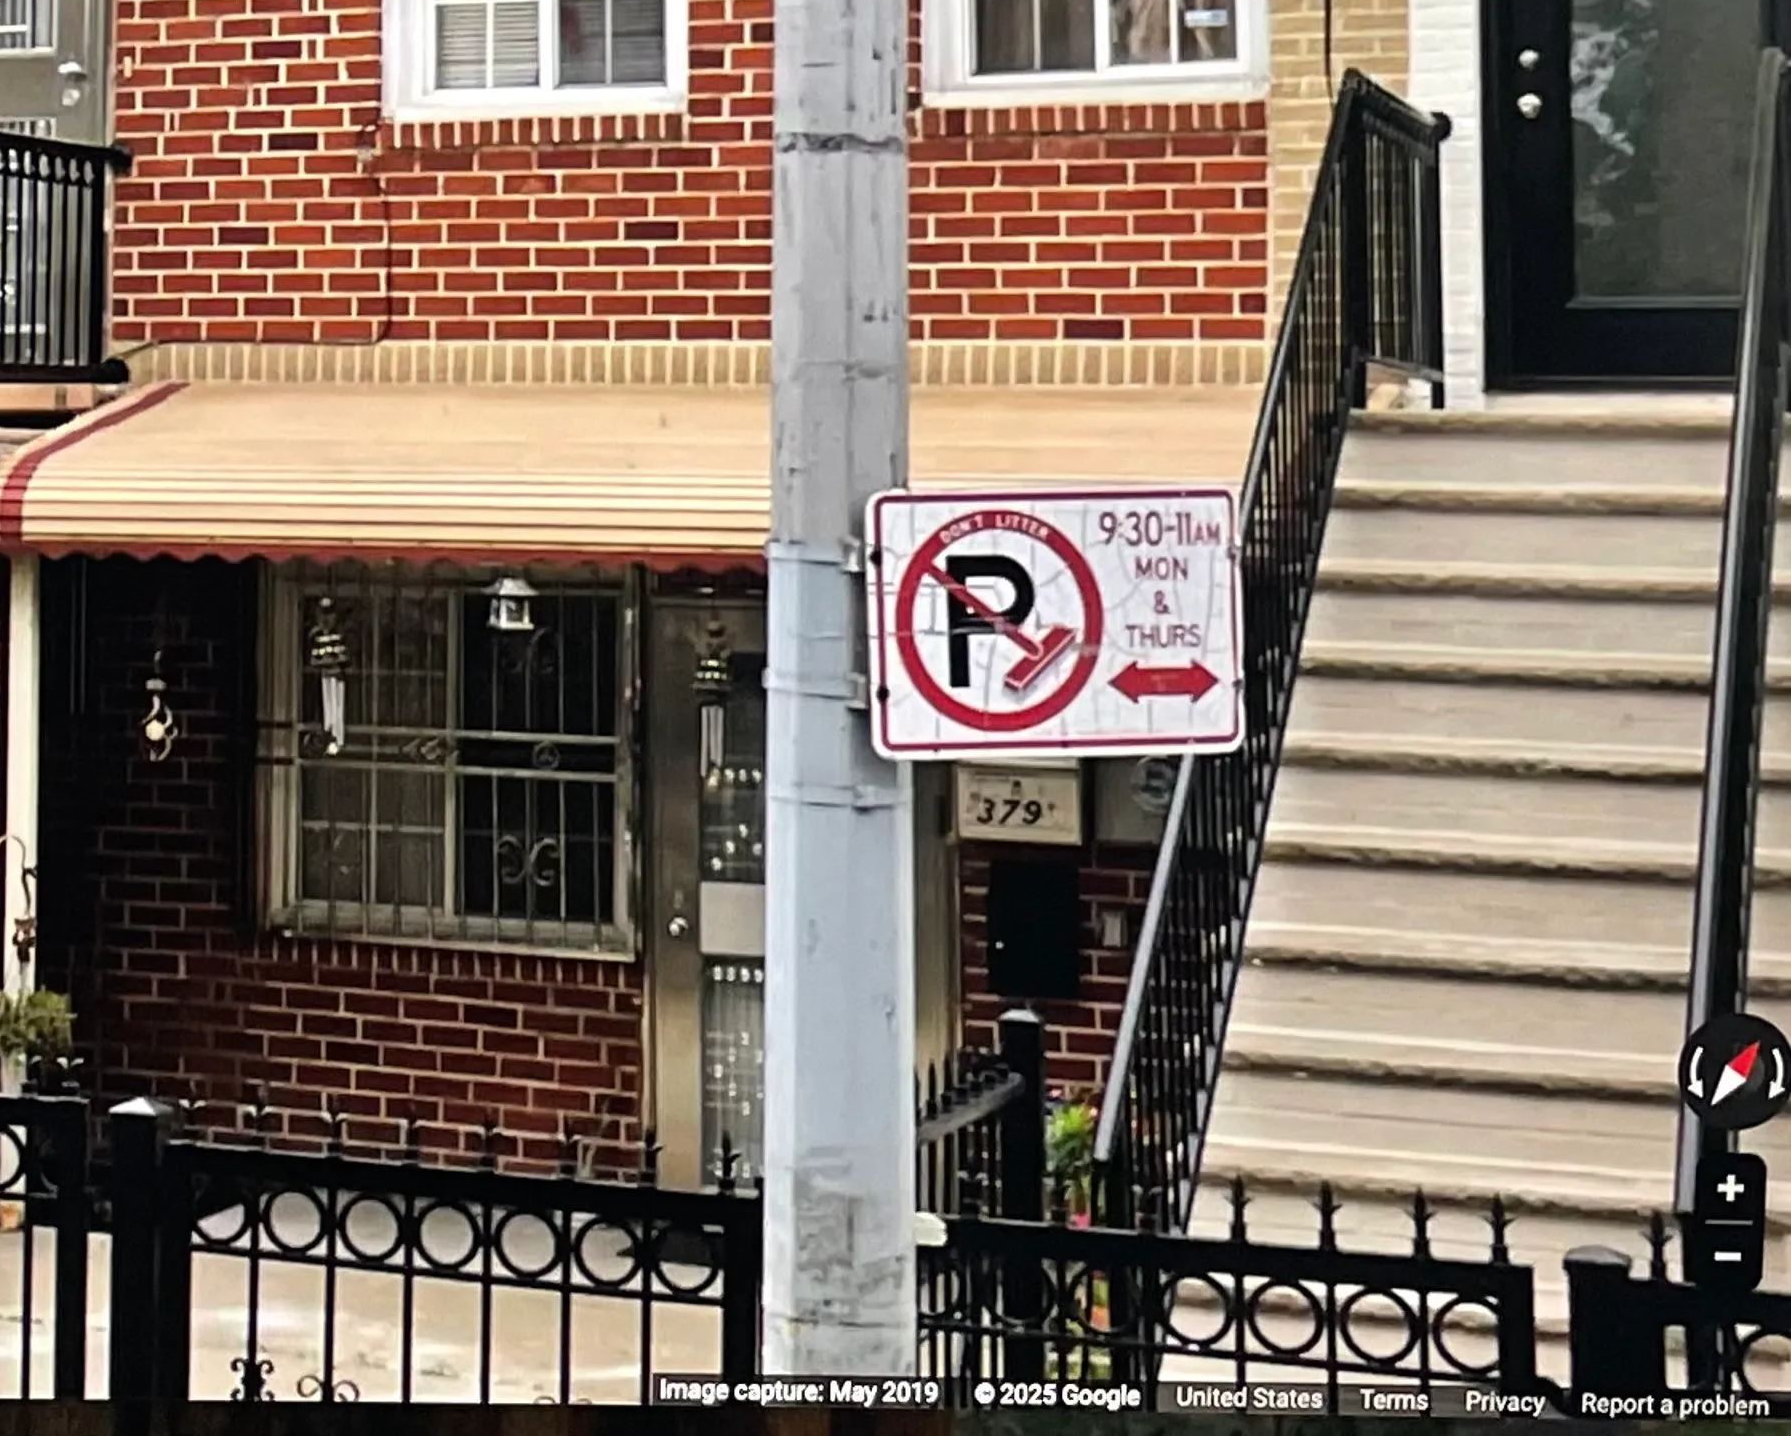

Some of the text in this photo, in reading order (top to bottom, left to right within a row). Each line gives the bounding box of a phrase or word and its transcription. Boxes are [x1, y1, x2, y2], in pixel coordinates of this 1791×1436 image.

[939, 514, 1049, 543] DON'T LITTER
[1135, 556, 1189, 580] MON
[1154, 590, 1171, 615] &
[1125, 624, 1202, 649] THURS
[976, 798, 1043, 825] 379
